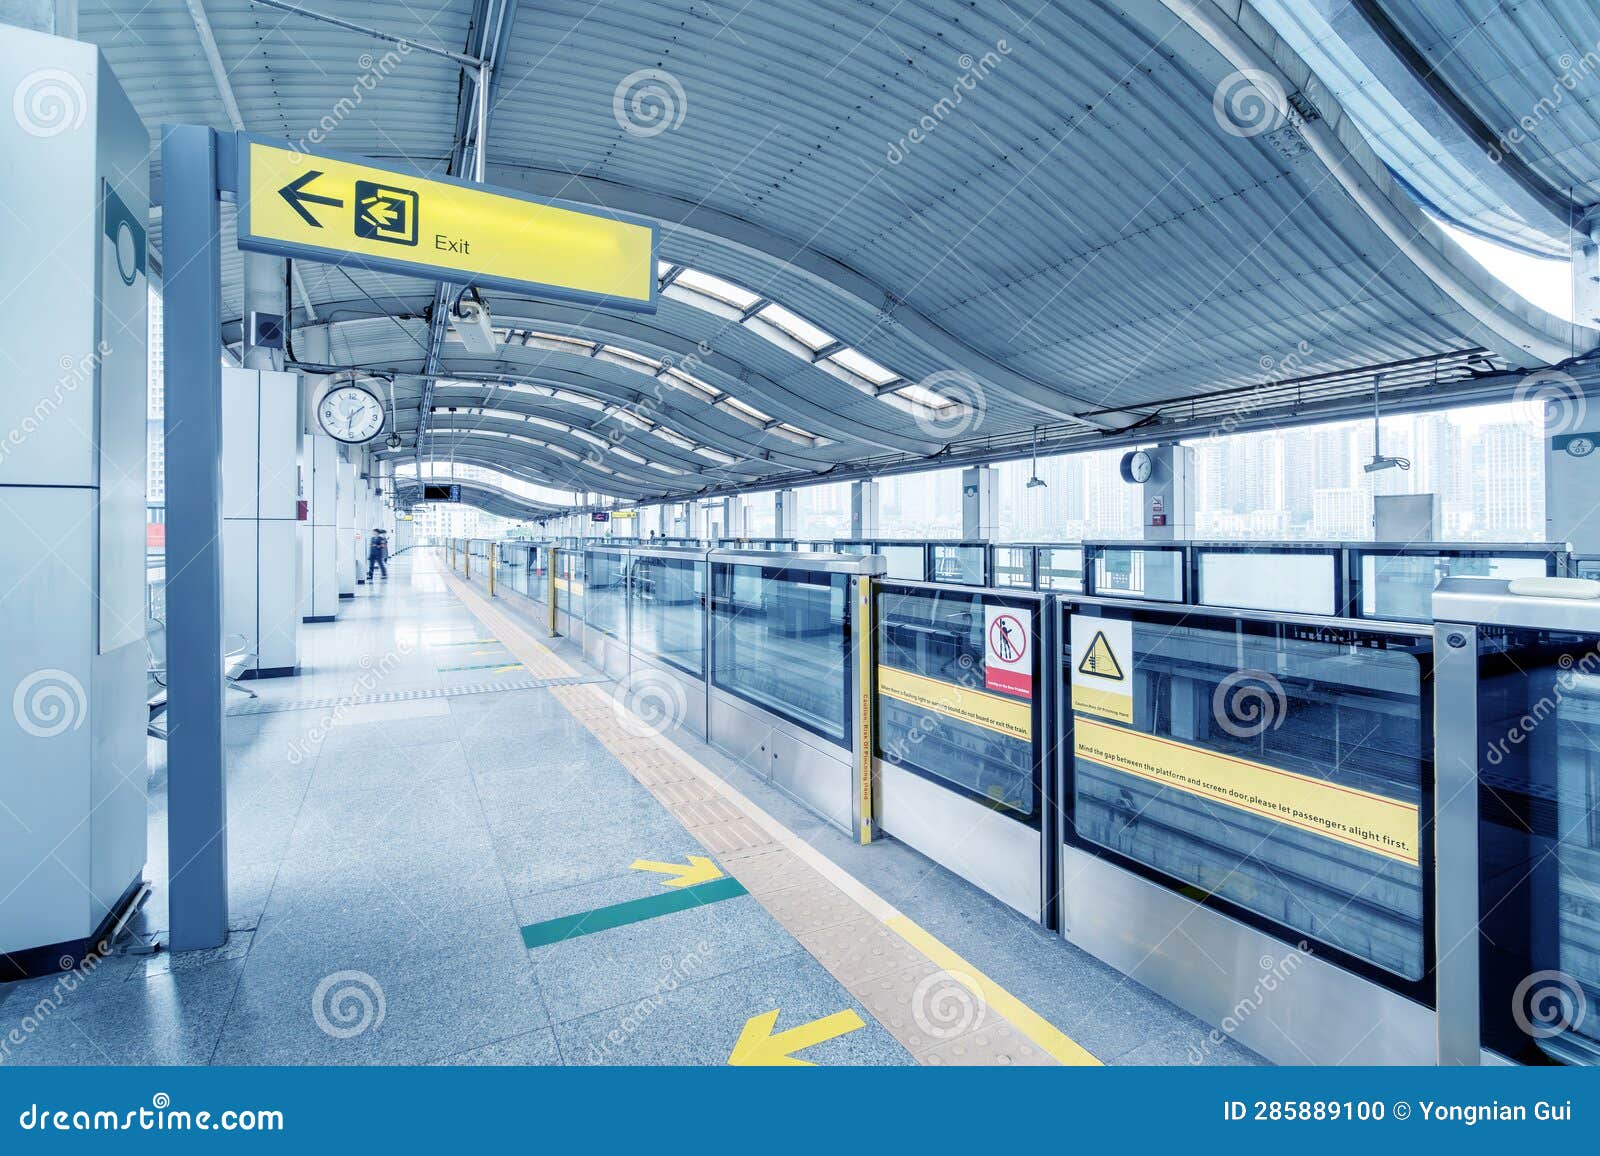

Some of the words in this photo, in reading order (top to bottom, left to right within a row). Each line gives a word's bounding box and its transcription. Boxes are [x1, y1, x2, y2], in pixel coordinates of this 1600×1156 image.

[435, 234, 470, 255] Exit
[348, 392, 358, 400] 12
[975, 711, 990, 724] board
[995, 719, 1005, 728] exit
[1005, 721, 1014, 730] the
[1078, 743, 1093, 754] Mind
[1093, 748, 1103, 757] the
[1104, 752, 1116, 761] gap
[1116, 755, 1143, 768] between
[1143, 762, 1155, 772] the
[1155, 767, 1186, 782] platform
[1187, 776, 1201, 786] and
[1202, 782, 1227, 795] screen
[1278, 803, 1291, 814] let
[1292, 808, 1347, 831] passengers
[1348, 826, 1380, 842] alight
[1382, 835, 1409, 851] first.
